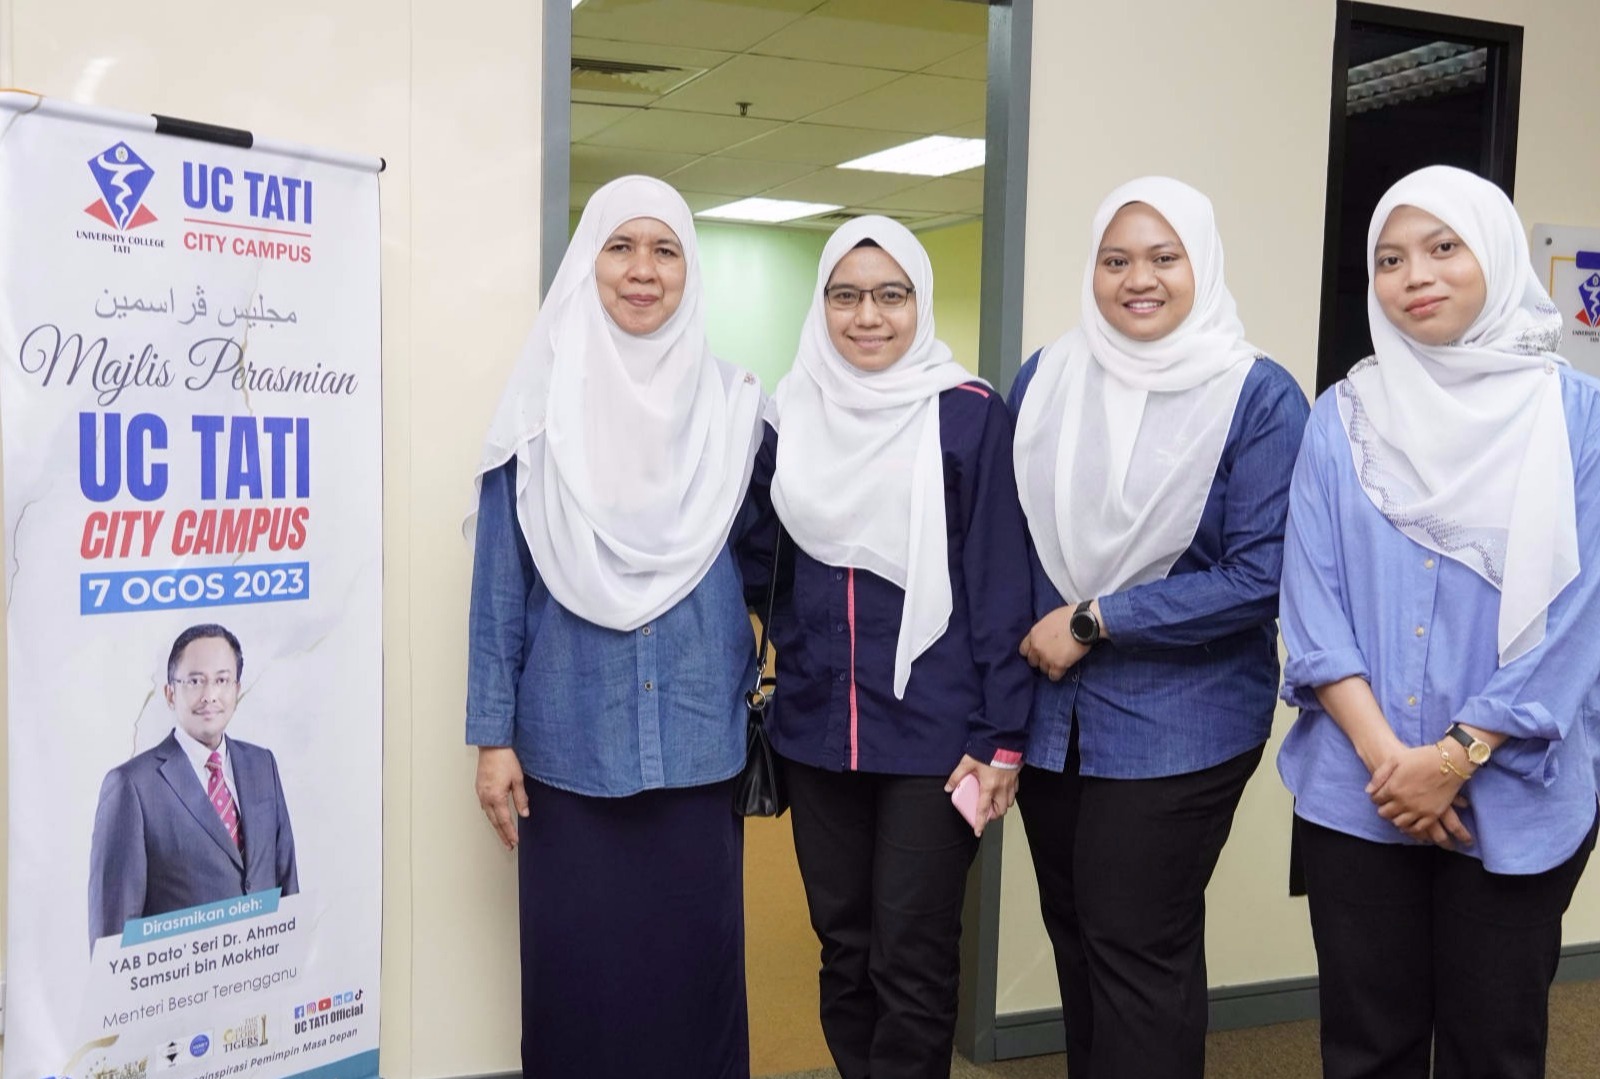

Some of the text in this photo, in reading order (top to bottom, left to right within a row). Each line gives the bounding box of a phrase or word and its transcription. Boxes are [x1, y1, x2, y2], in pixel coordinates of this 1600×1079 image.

[182, 160, 313, 225] UC TATI
[76, 230, 166, 249] UNIVERSITY COLLEGE
[112, 244, 131, 254] TATI
[182, 231, 312, 264] CITY CAMPUS
[19, 323, 359, 407] Majlis Perasmian
[78, 411, 310, 503] UC TATI
[79, 506, 310, 560] CITY CAMPUS
[88, 568, 305, 608] 7 OGOS 2023
[142, 898, 263, 937] Dirasmikan oleh:
[109, 917, 296, 975] YAB Dato' Seri Dr. Ahmad
[130, 943, 280, 991] Samsuri bin Mokhtar
[102, 966, 298, 1029] Menteri Besar Terengganu
[294, 1003, 364, 1035] UC TATI Official
[250, 1047, 300, 1068] Pemimpin
[302, 1040, 327, 1053] Masa
[329, 1028, 358, 1046] Depan
